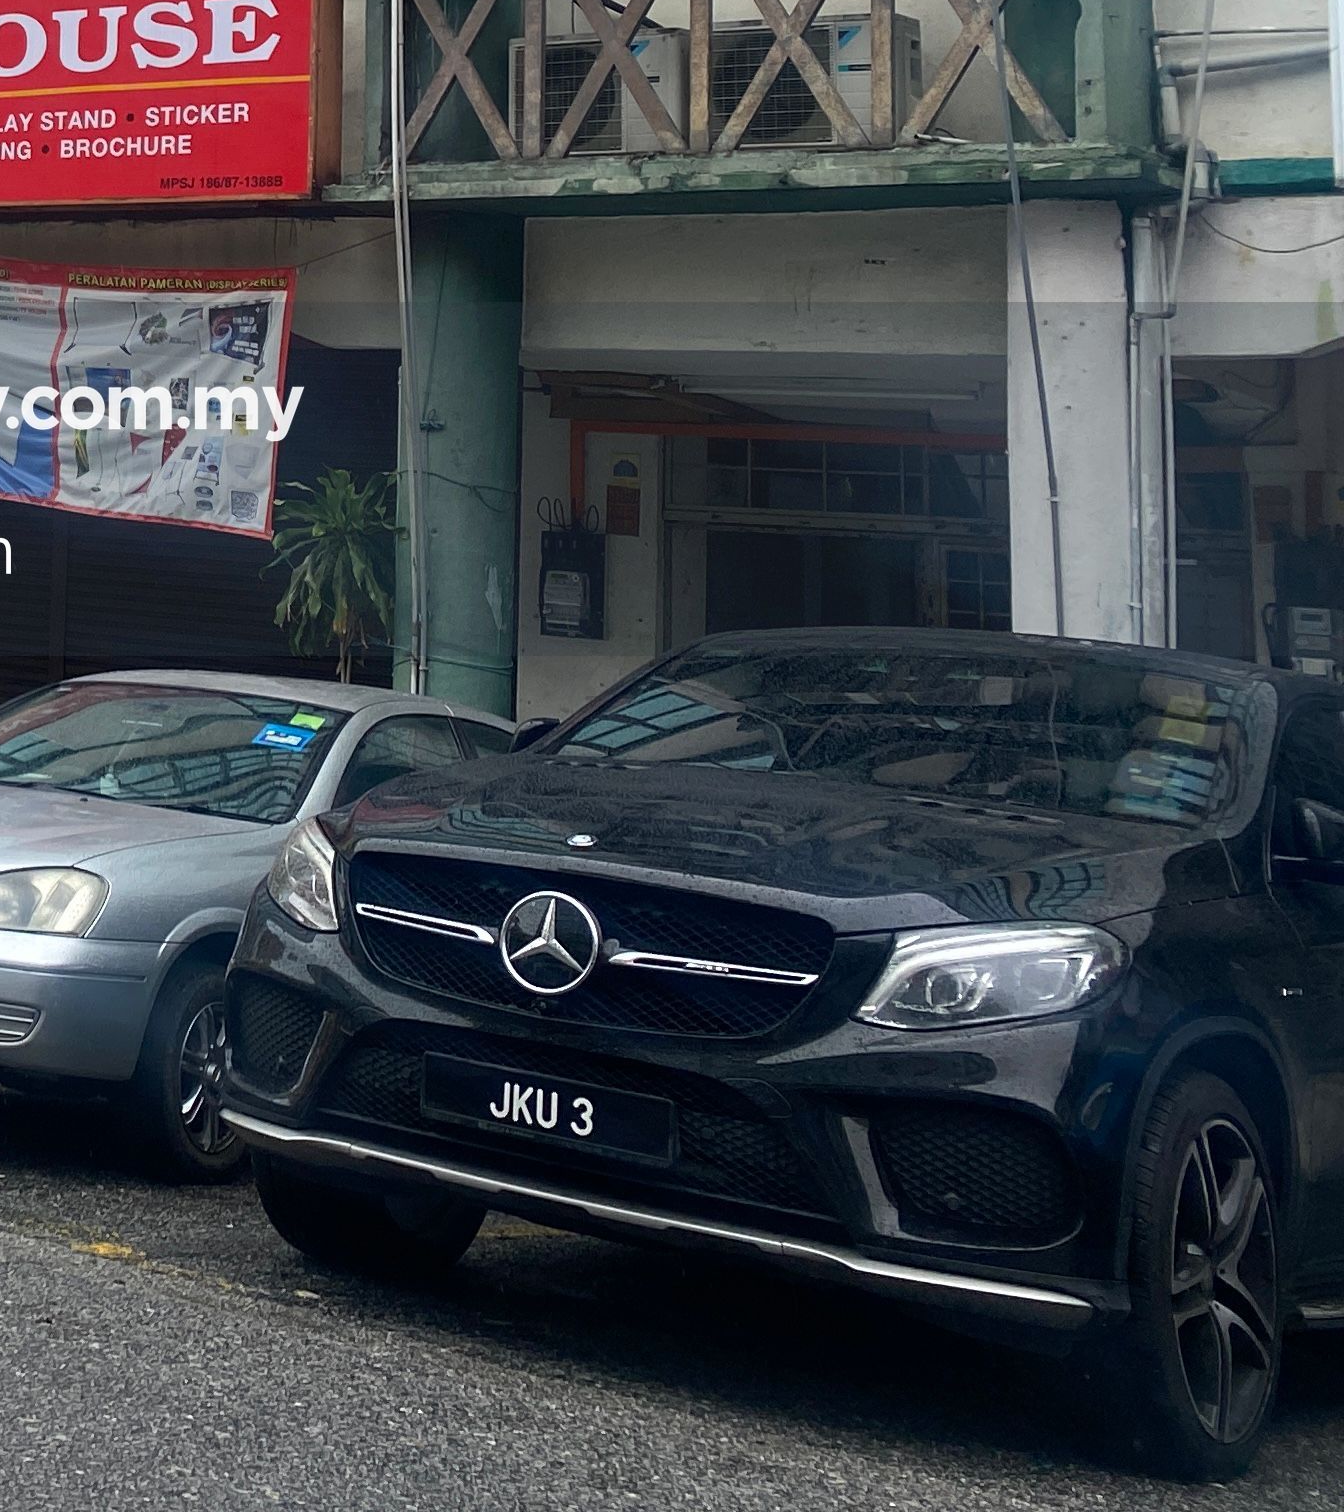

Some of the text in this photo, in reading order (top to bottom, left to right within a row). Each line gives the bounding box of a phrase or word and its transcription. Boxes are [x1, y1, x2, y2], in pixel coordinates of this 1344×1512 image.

[40, 109, 116, 131] STAND
[145, 103, 250, 127] STICKER
[59, 135, 192, 159] BROCHURE
[160, 177, 196, 190] MPSJ
[68, 273, 136, 288] PERALATAN
[141, 277, 203, 289] PAMERAN
[489, 1081, 594, 1136] JKU 3
